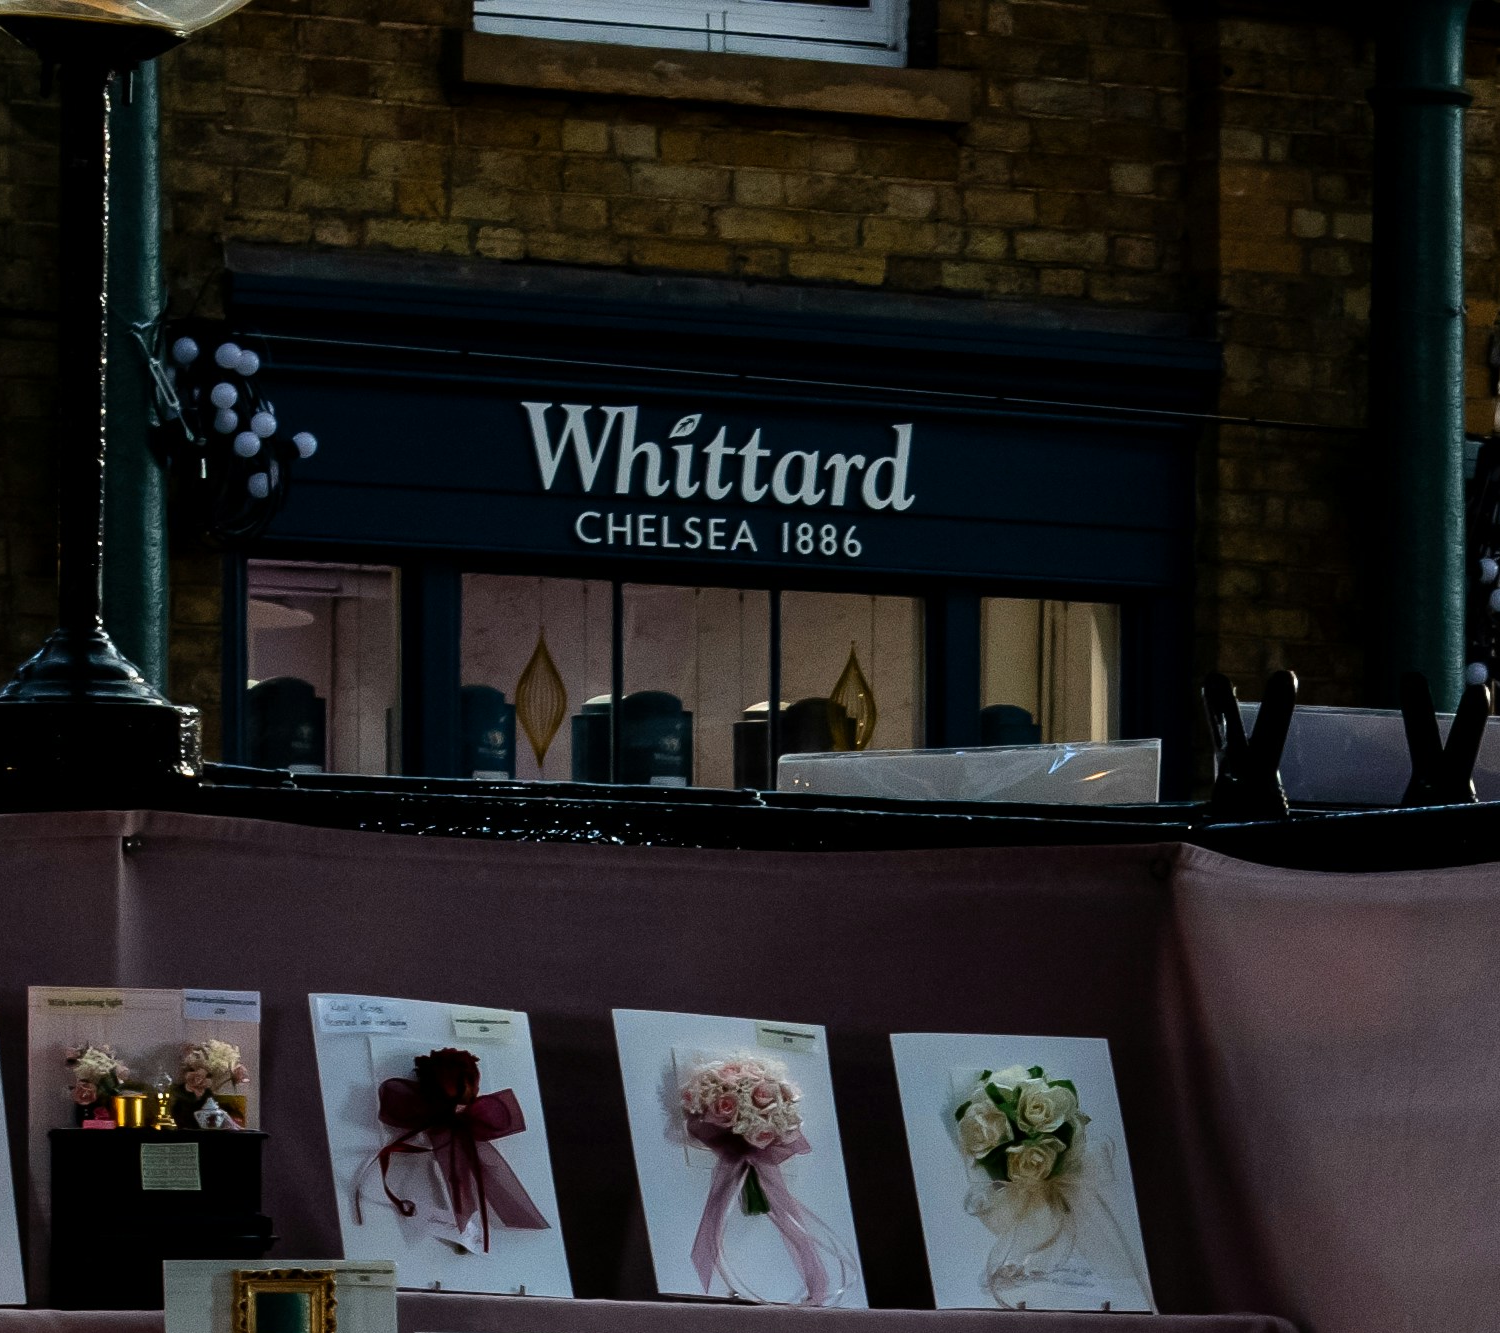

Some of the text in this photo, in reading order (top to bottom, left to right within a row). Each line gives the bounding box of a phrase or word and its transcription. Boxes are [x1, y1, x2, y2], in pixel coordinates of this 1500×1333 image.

[520, 400, 916, 511] Whittard
[574, 510, 863, 557] CHELSEA 1886
